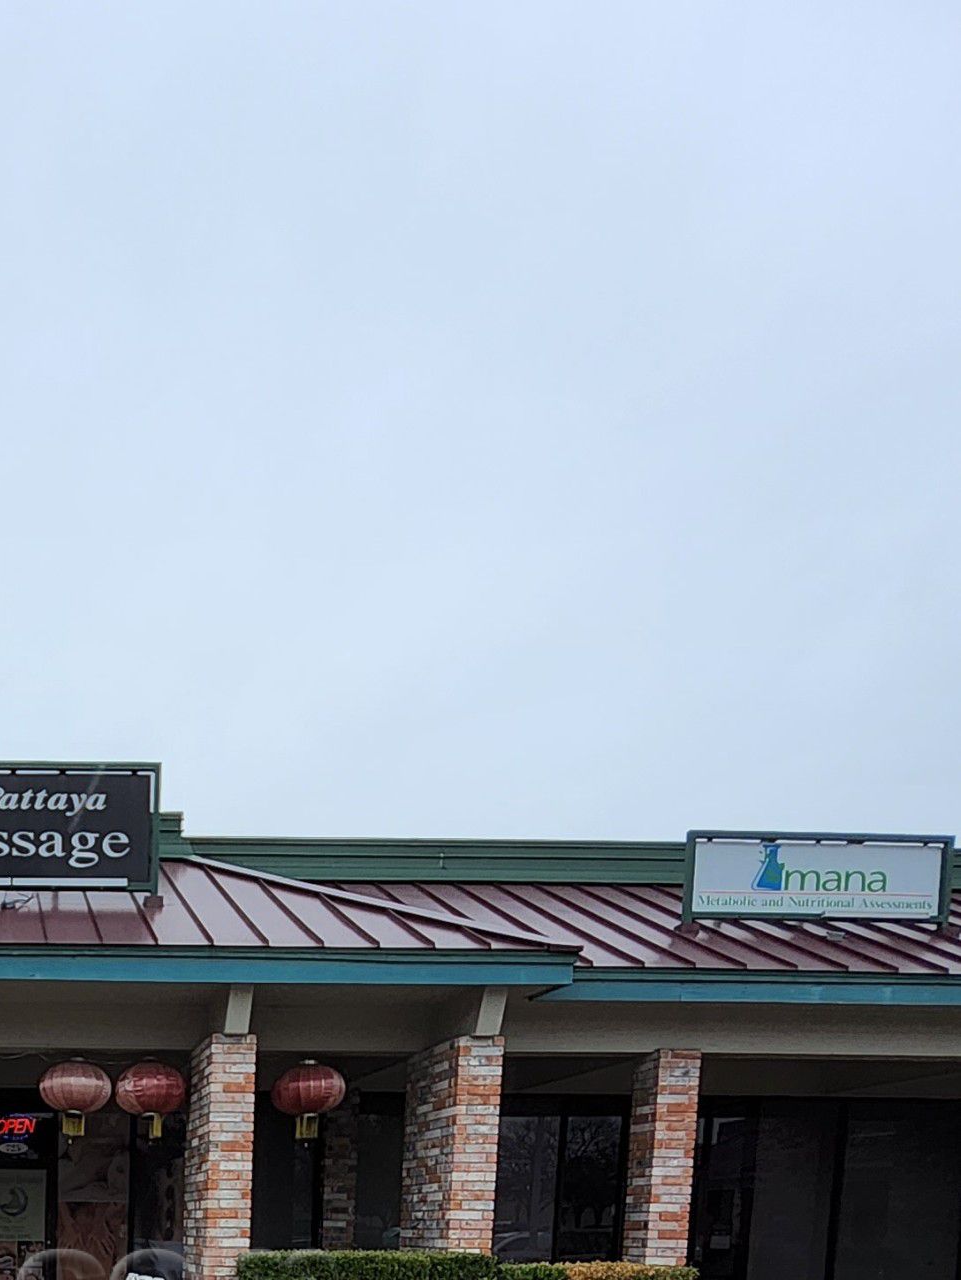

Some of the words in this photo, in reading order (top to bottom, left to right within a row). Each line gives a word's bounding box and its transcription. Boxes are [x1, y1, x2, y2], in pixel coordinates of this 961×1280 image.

[697, 894, 757, 908] Metabolic
[761, 895, 784, 908] and
[788, 896, 855, 909] Nutritional
[859, 898, 934, 911] Assessments
